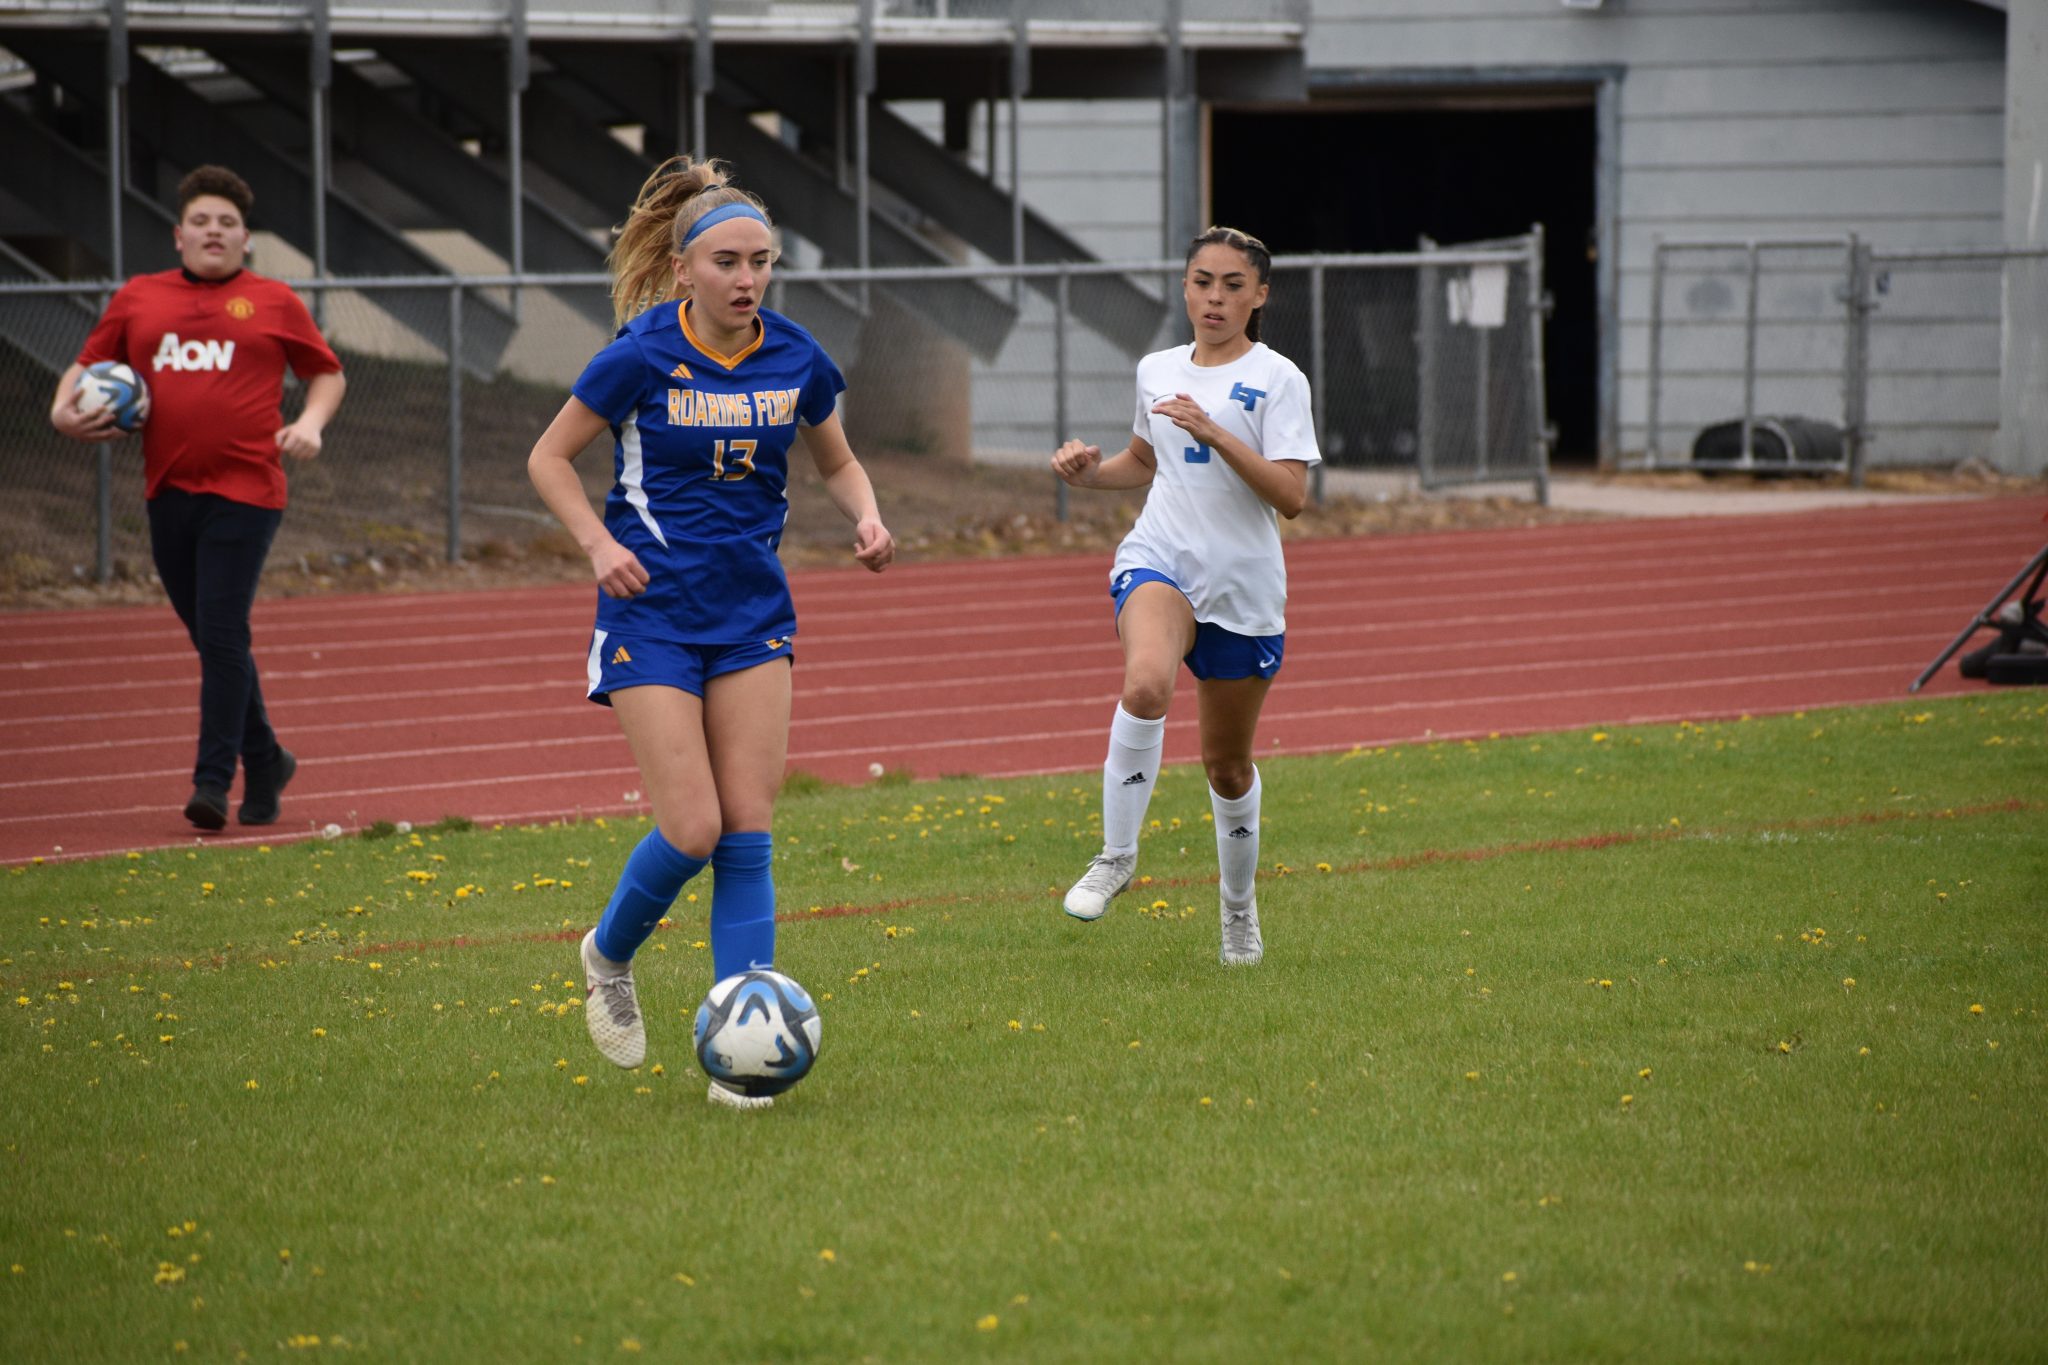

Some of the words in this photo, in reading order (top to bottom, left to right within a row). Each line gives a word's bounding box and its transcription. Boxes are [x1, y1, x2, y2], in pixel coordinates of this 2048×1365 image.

[667, 388, 752, 427] ROARING
[752, 387, 801, 427] FORK
[707, 439, 758, 481] 13
